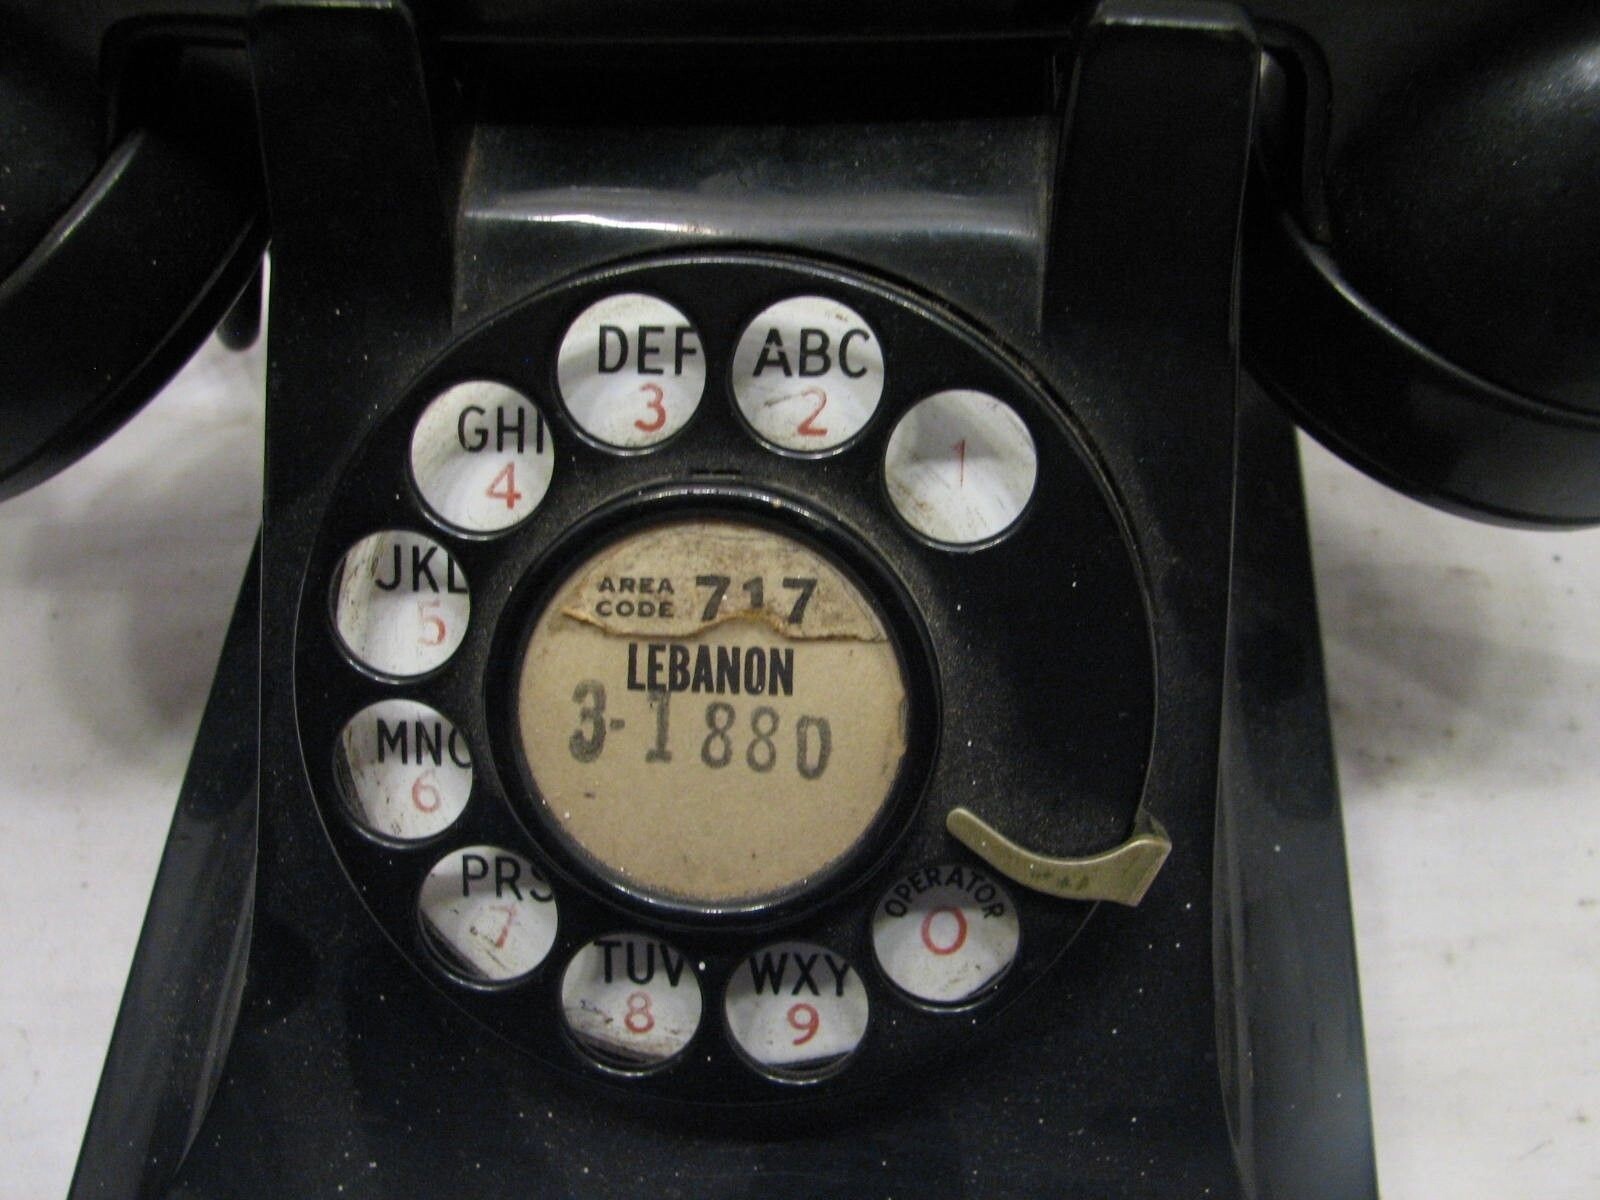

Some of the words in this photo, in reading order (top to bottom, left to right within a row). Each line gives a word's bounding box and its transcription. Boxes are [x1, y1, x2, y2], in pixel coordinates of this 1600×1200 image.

[598, 325, 699, 376] DEF
[753, 328, 870, 378] ABC
[457, 405, 544, 454] GHI
[634, 383, 666, 432] 3
[796, 389, 828, 437] 2
[485, 461, 522, 509] 4
[951, 439, 966, 488] 1
[375, 544, 468, 594] JKL
[418, 600, 446, 645] 5
[595, 600, 675, 618] CODE
[598, 576, 675, 594] AREA
[696, 574, 818, 626] 717
[627, 643, 794, 696] LEBANON
[411, 769, 441, 814] 6
[885, 867, 1005, 919] OPERATOR
[489, 904, 517, 949] 7
[594, 941, 685, 987] TUV
[750, 952, 850, 997] WXY
[624, 992, 654, 1033] 8
[787, 1003, 820, 1046] 9
